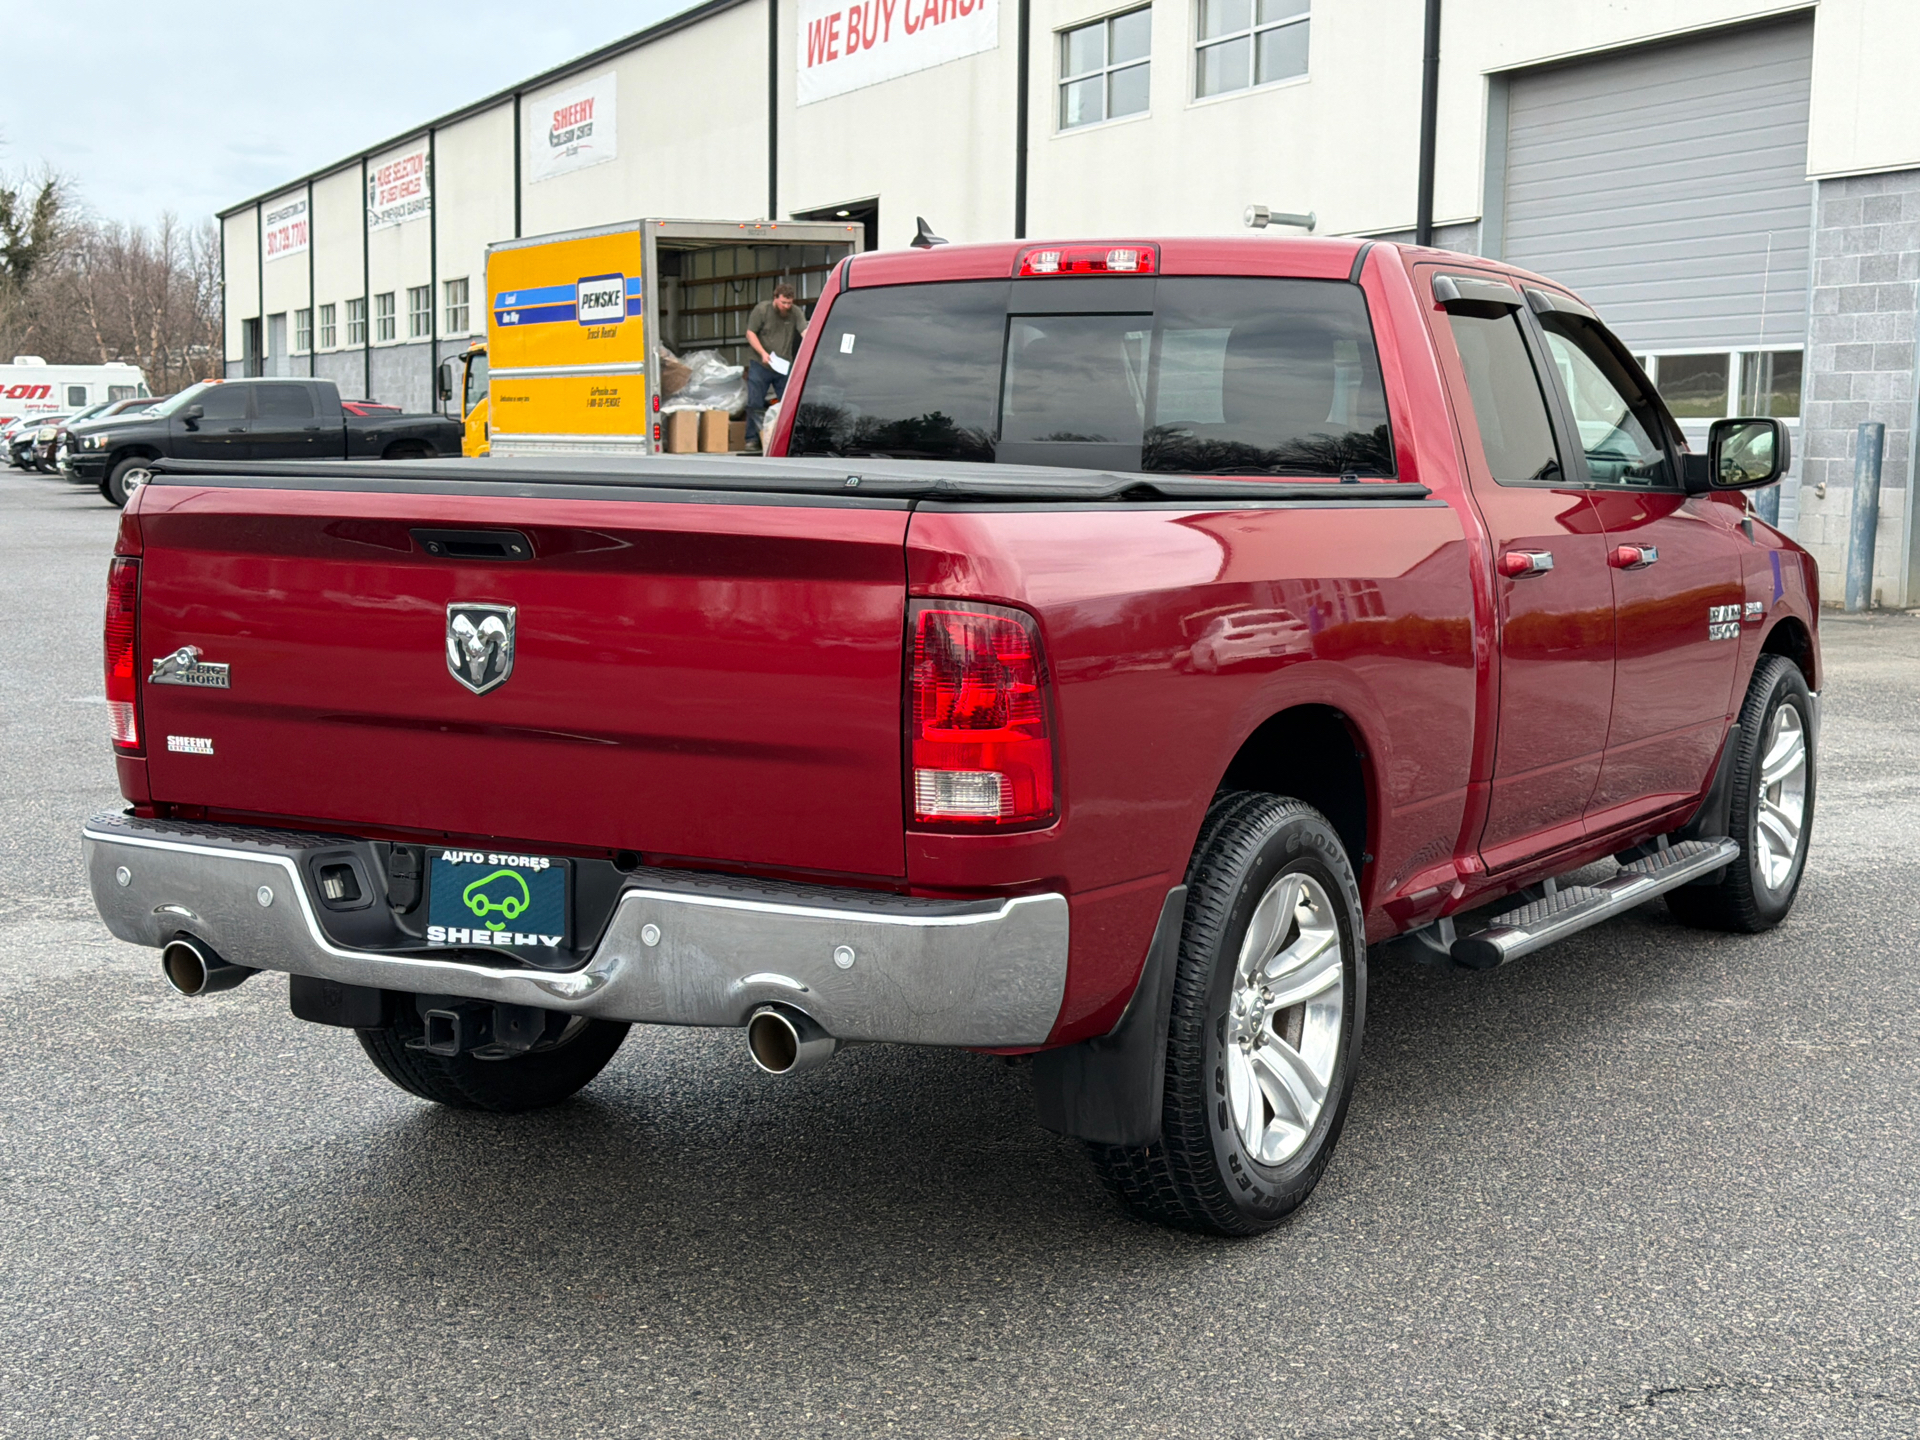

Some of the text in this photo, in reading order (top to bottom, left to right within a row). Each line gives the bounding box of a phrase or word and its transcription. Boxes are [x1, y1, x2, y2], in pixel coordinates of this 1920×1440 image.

[807, 11, 841, 68] WE
[845, 0, 896, 56] BUY
[553, 96, 595, 132] SHEEHY
[581, 290, 621, 309] PENSKE
[0, 384, 52, 399] -on
[1709, 604, 1741, 623] RAM
[1709, 622, 1740, 641] 1500
[196, 665, 221, 675] BIG
[186, 674, 226, 686] HORN
[167, 735, 212, 748] SHEEHY
[442, 850, 550, 869] AUTO STORES
[426, 926, 563, 947] SHEEHY
